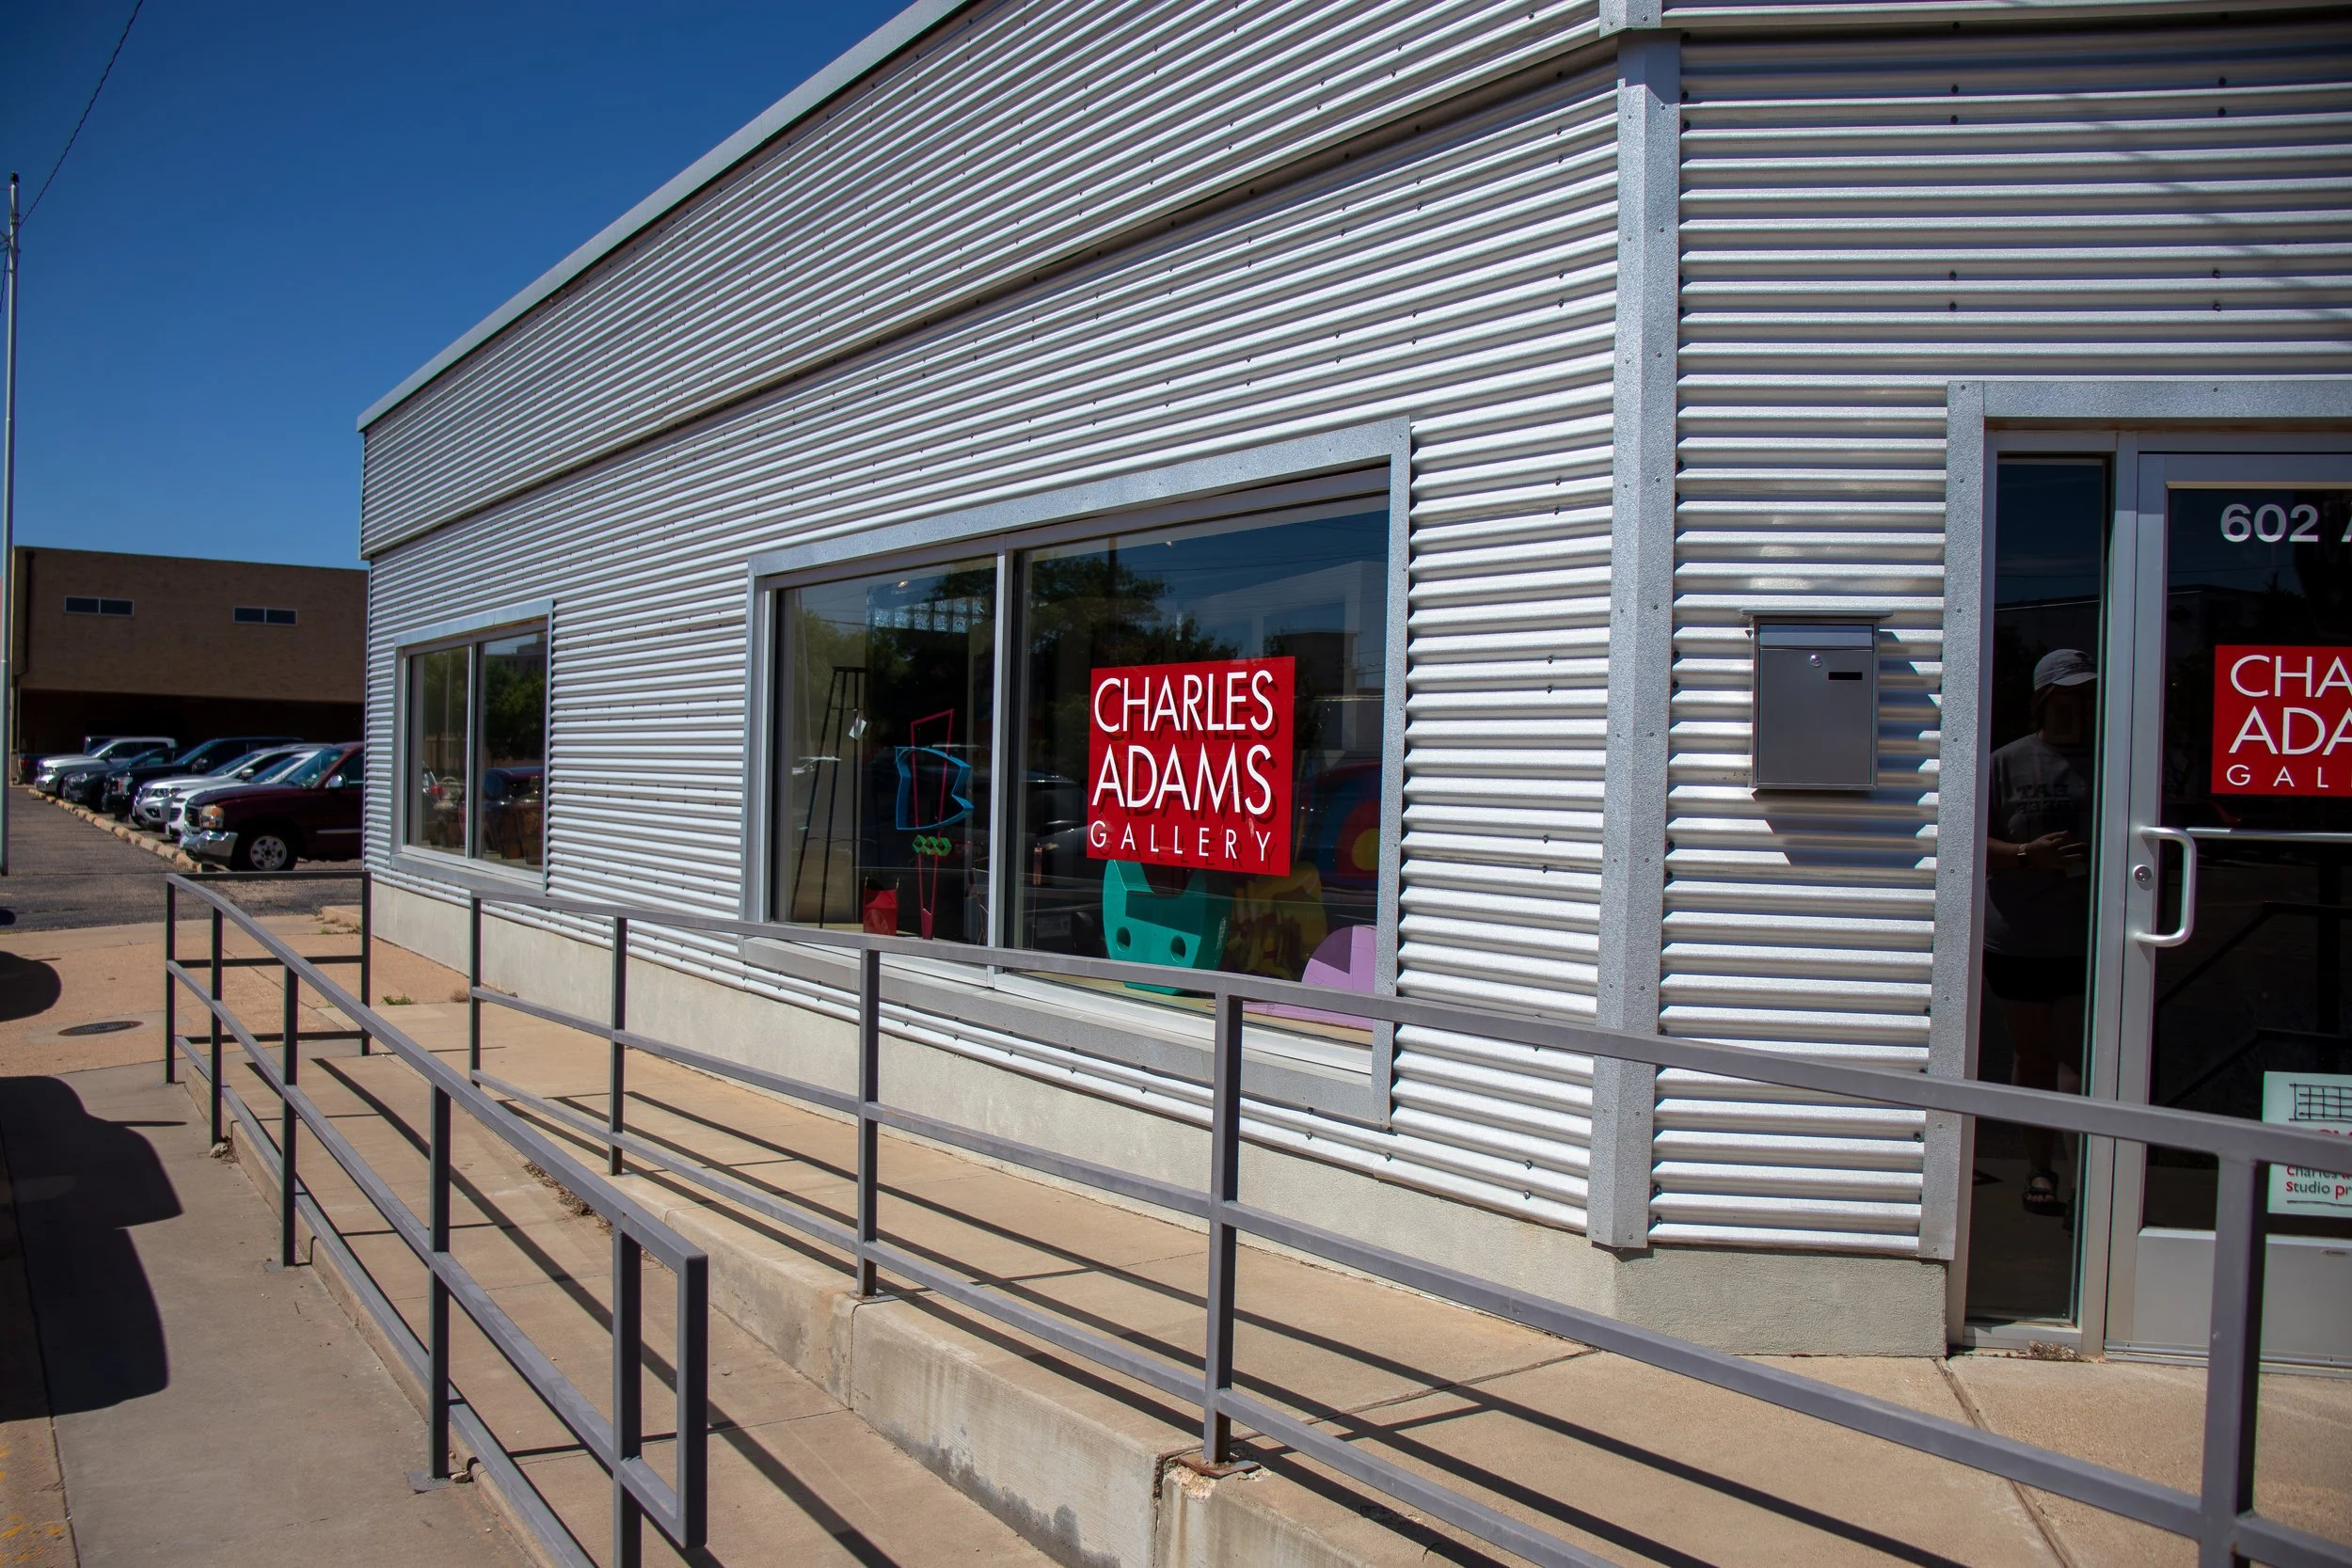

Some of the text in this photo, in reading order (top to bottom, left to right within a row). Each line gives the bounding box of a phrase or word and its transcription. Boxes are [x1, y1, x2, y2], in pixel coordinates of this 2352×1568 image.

[2220, 503, 2319, 543] 602
[1094, 670, 1273, 733] CHARLES
[1092, 742, 1271, 816] ADAMS
[1090, 820, 1271, 862] GALLERY
